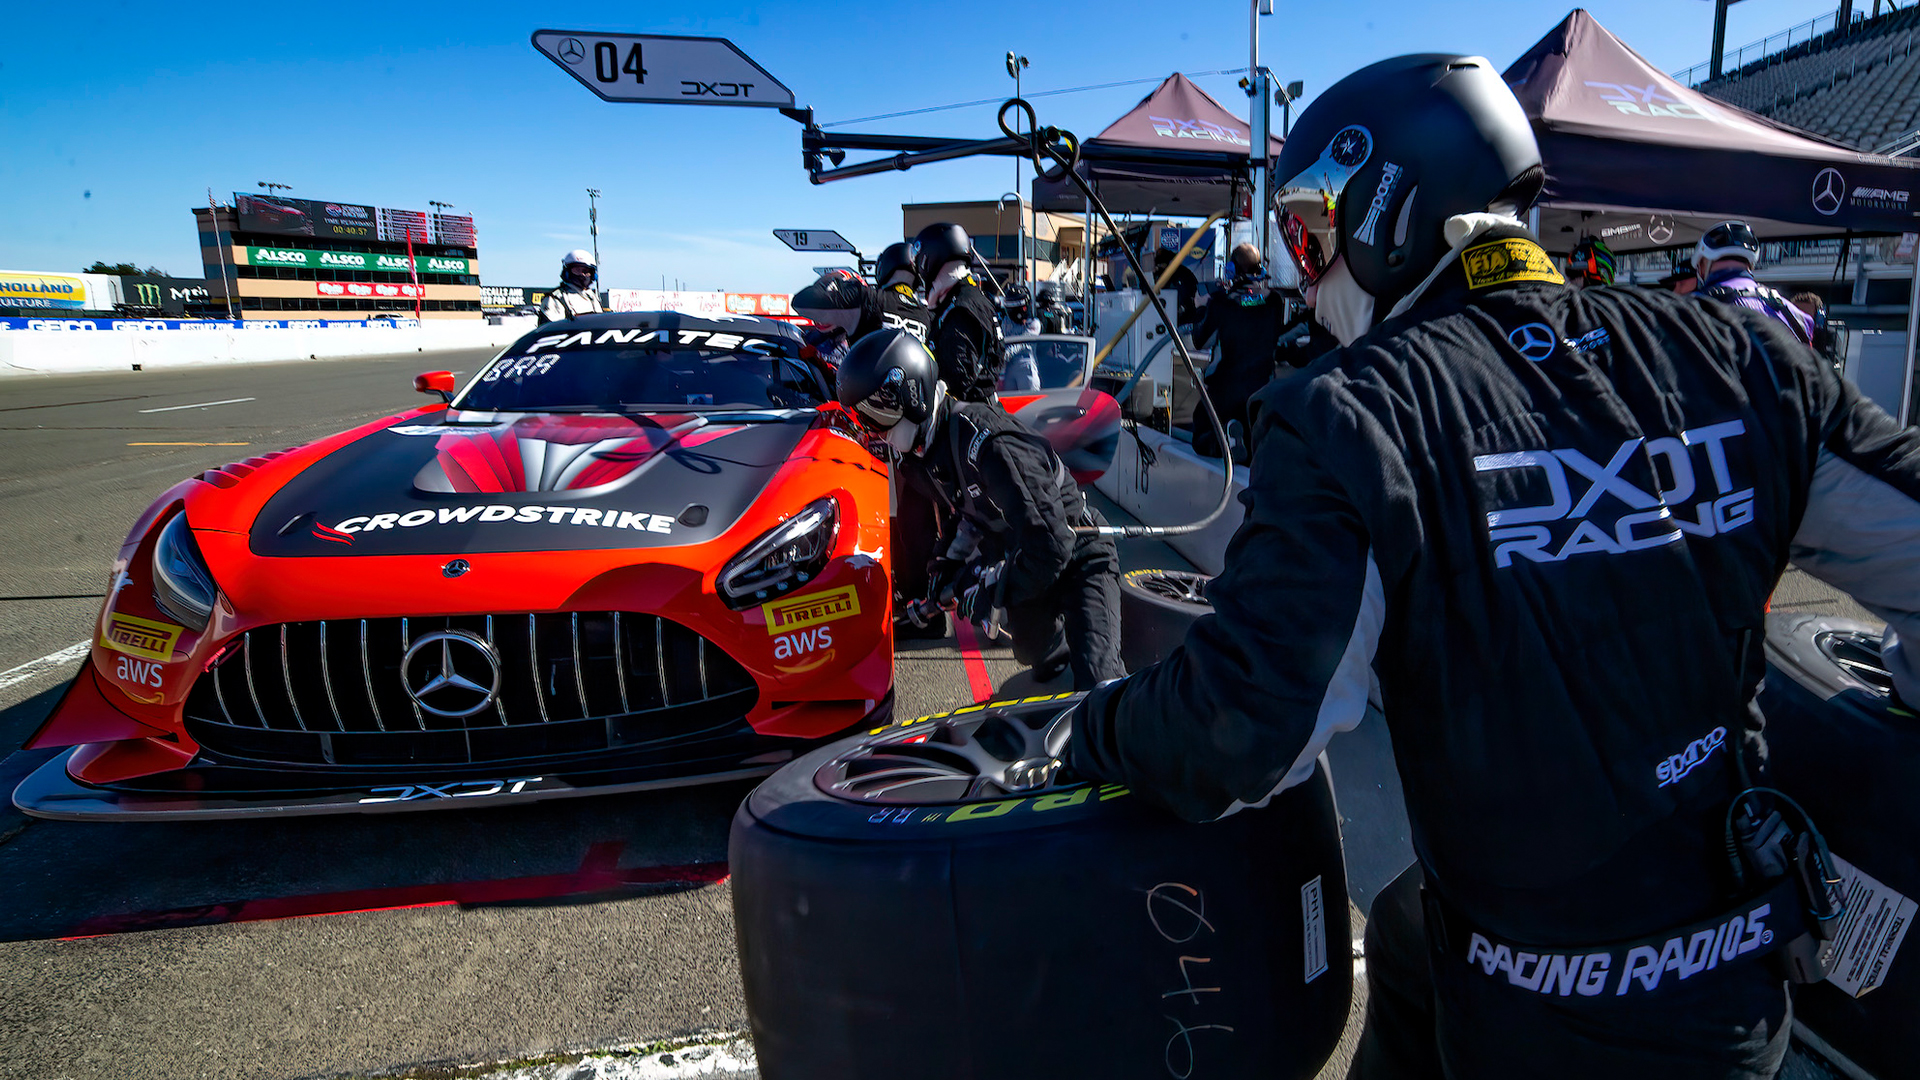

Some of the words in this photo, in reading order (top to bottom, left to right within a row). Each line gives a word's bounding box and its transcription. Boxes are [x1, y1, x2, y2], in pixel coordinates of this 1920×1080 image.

[594, 42, 648, 84] 04
[680, 80, 754, 98] DXDT
[1606, 100, 1706, 120] RAC
[1149, 115, 1242, 139] DXDT
[1152, 123, 1251, 147] RACING
[1370, 160, 1402, 210] paoli
[793, 231, 808, 246] 19
[255, 248, 308, 263] ALSCO
[319, 252, 366, 266] ALSCO
[427, 258, 466, 271] ALSCO
[0, 282, 74, 293] HOLLAND
[28, 320, 97, 331] GEICO
[112, 320, 168, 331] GEICO
[526, 328, 788, 357] FANATEC
[1472, 418, 1747, 520] DXDT
[333, 504, 676, 535] CROWDSTRIKE
[771, 592, 853, 627] PIRELLI
[107, 619, 173, 654] PIRELLI
[774, 625, 834, 660] aws
[116, 655, 164, 688] aws
[1655, 726, 1728, 787] sparco
[358, 776, 543, 805] DXDT
[1467, 932, 1612, 997] RACING
